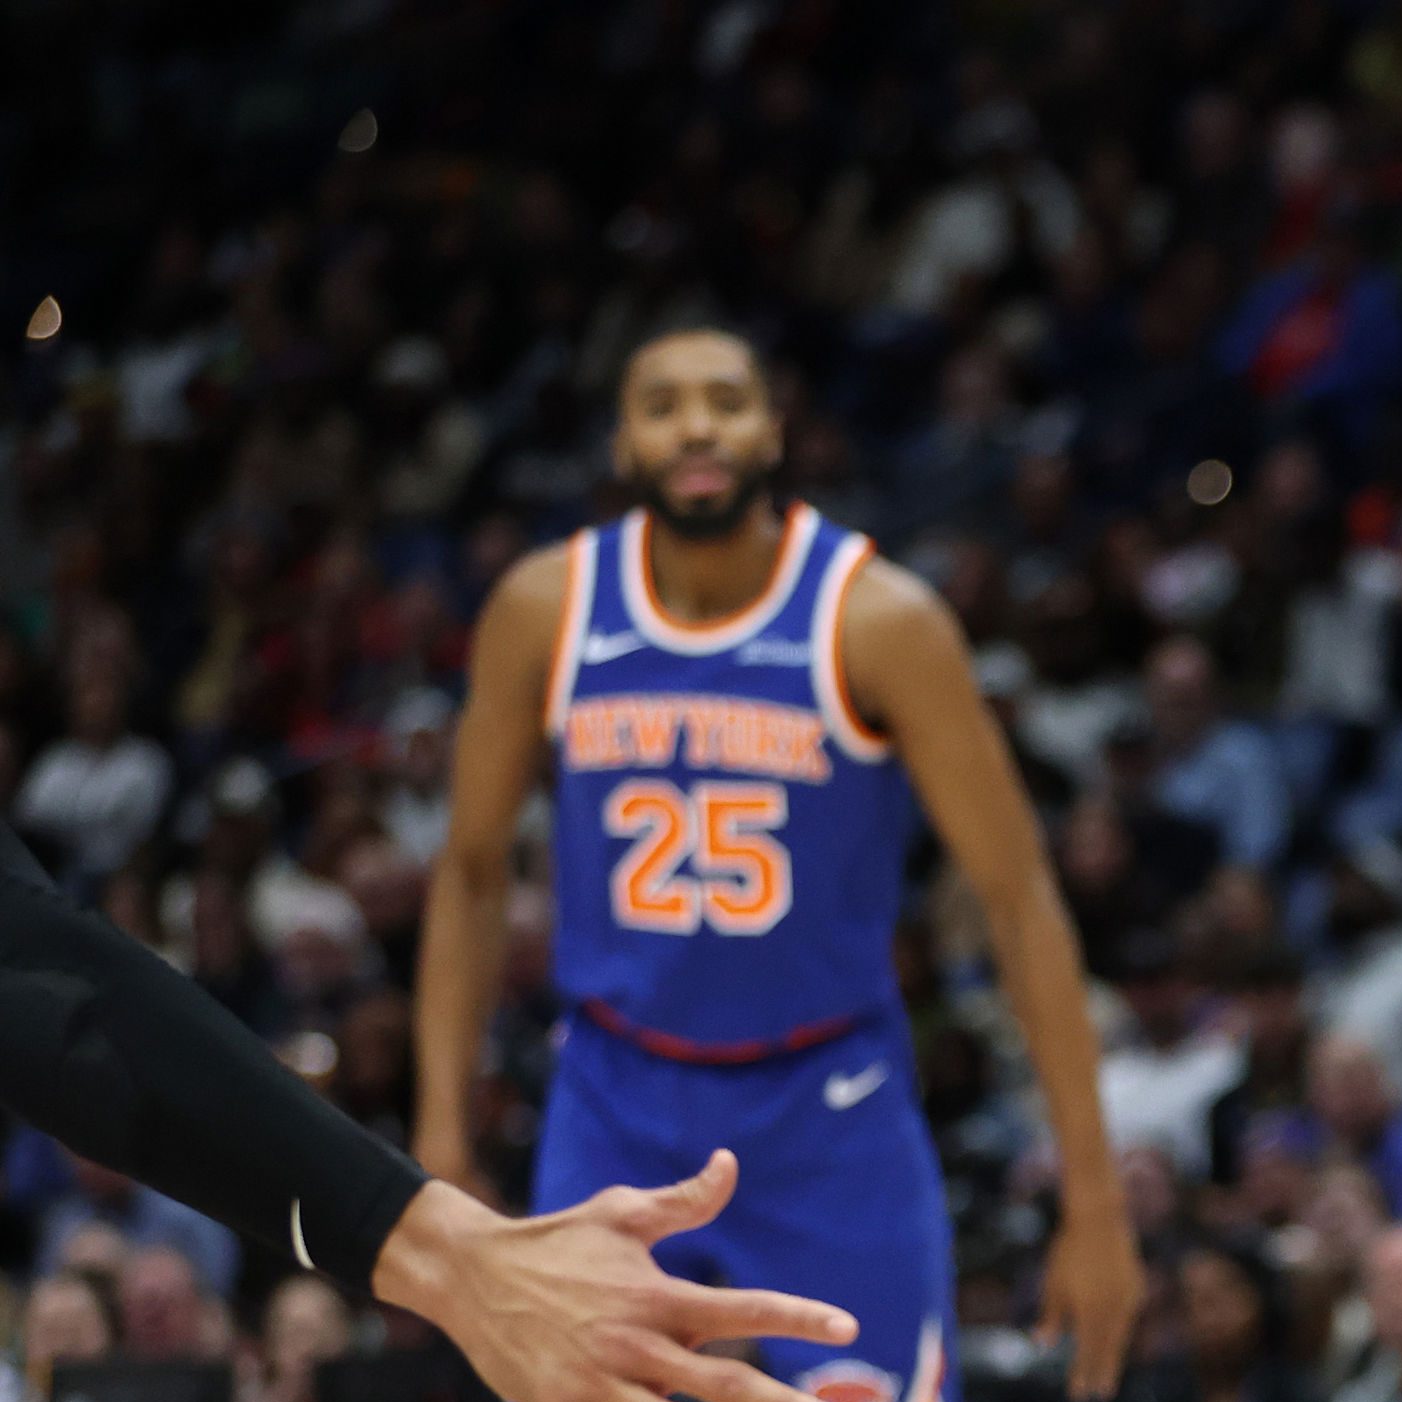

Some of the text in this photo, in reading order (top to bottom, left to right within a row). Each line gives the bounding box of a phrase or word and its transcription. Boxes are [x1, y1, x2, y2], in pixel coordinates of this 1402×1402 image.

[564, 693, 832, 785] NEW YORK
[603, 778, 793, 936] 25
